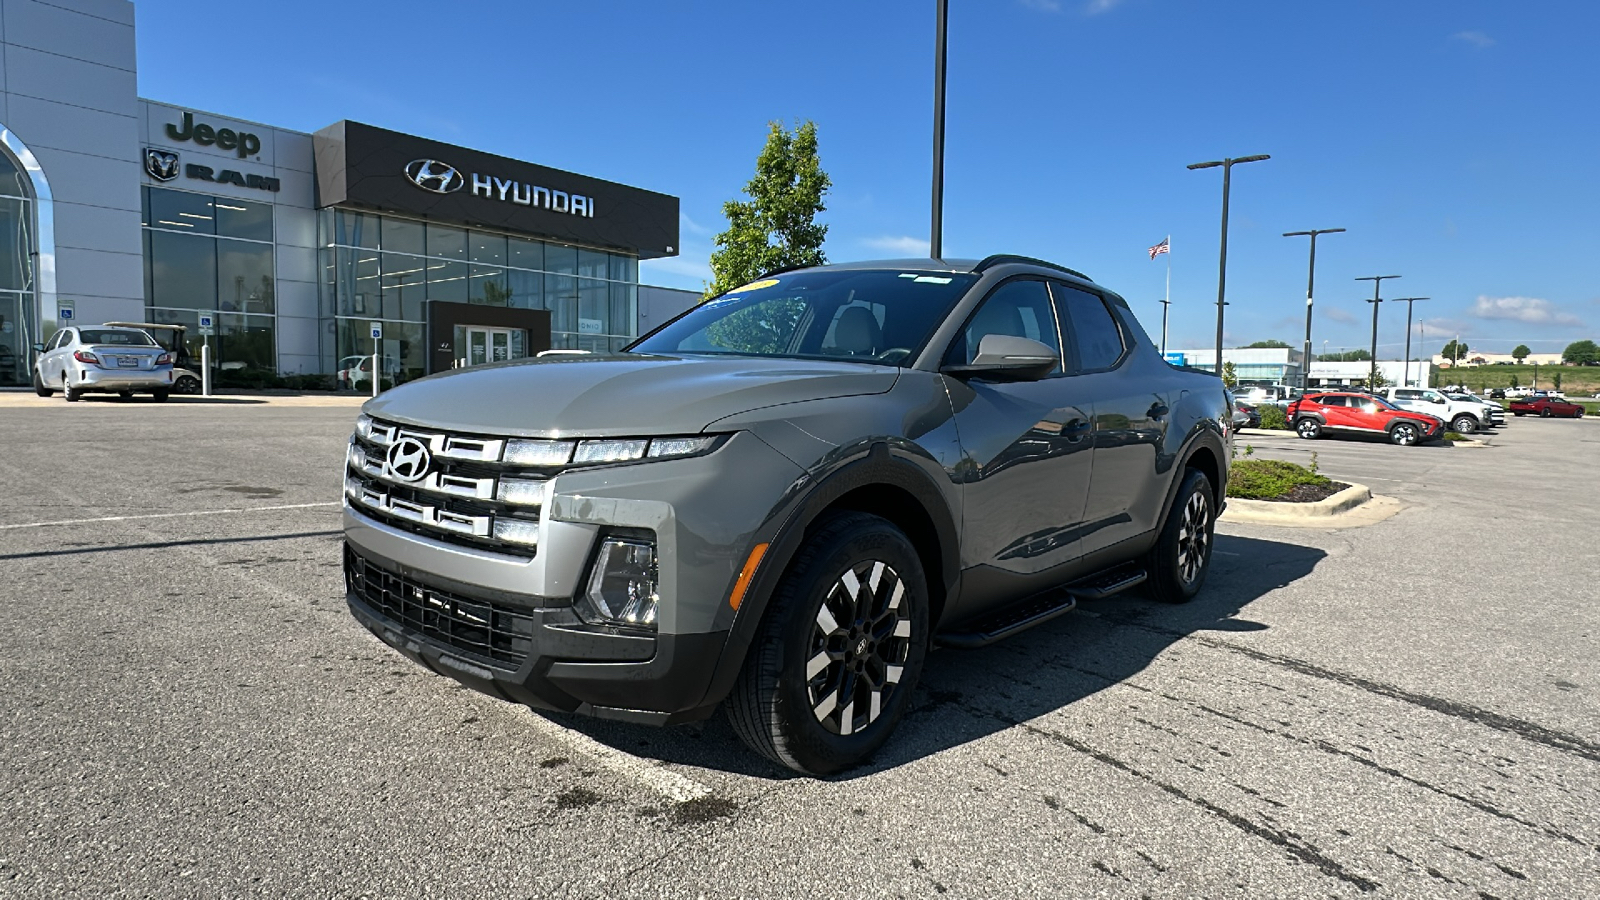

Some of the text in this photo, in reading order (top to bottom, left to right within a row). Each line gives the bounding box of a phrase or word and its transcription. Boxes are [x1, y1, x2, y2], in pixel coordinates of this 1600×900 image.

[166, 111, 261, 159] Jeep
[186, 163, 281, 193] RAM
[471, 172, 595, 218] HYUNDAI
